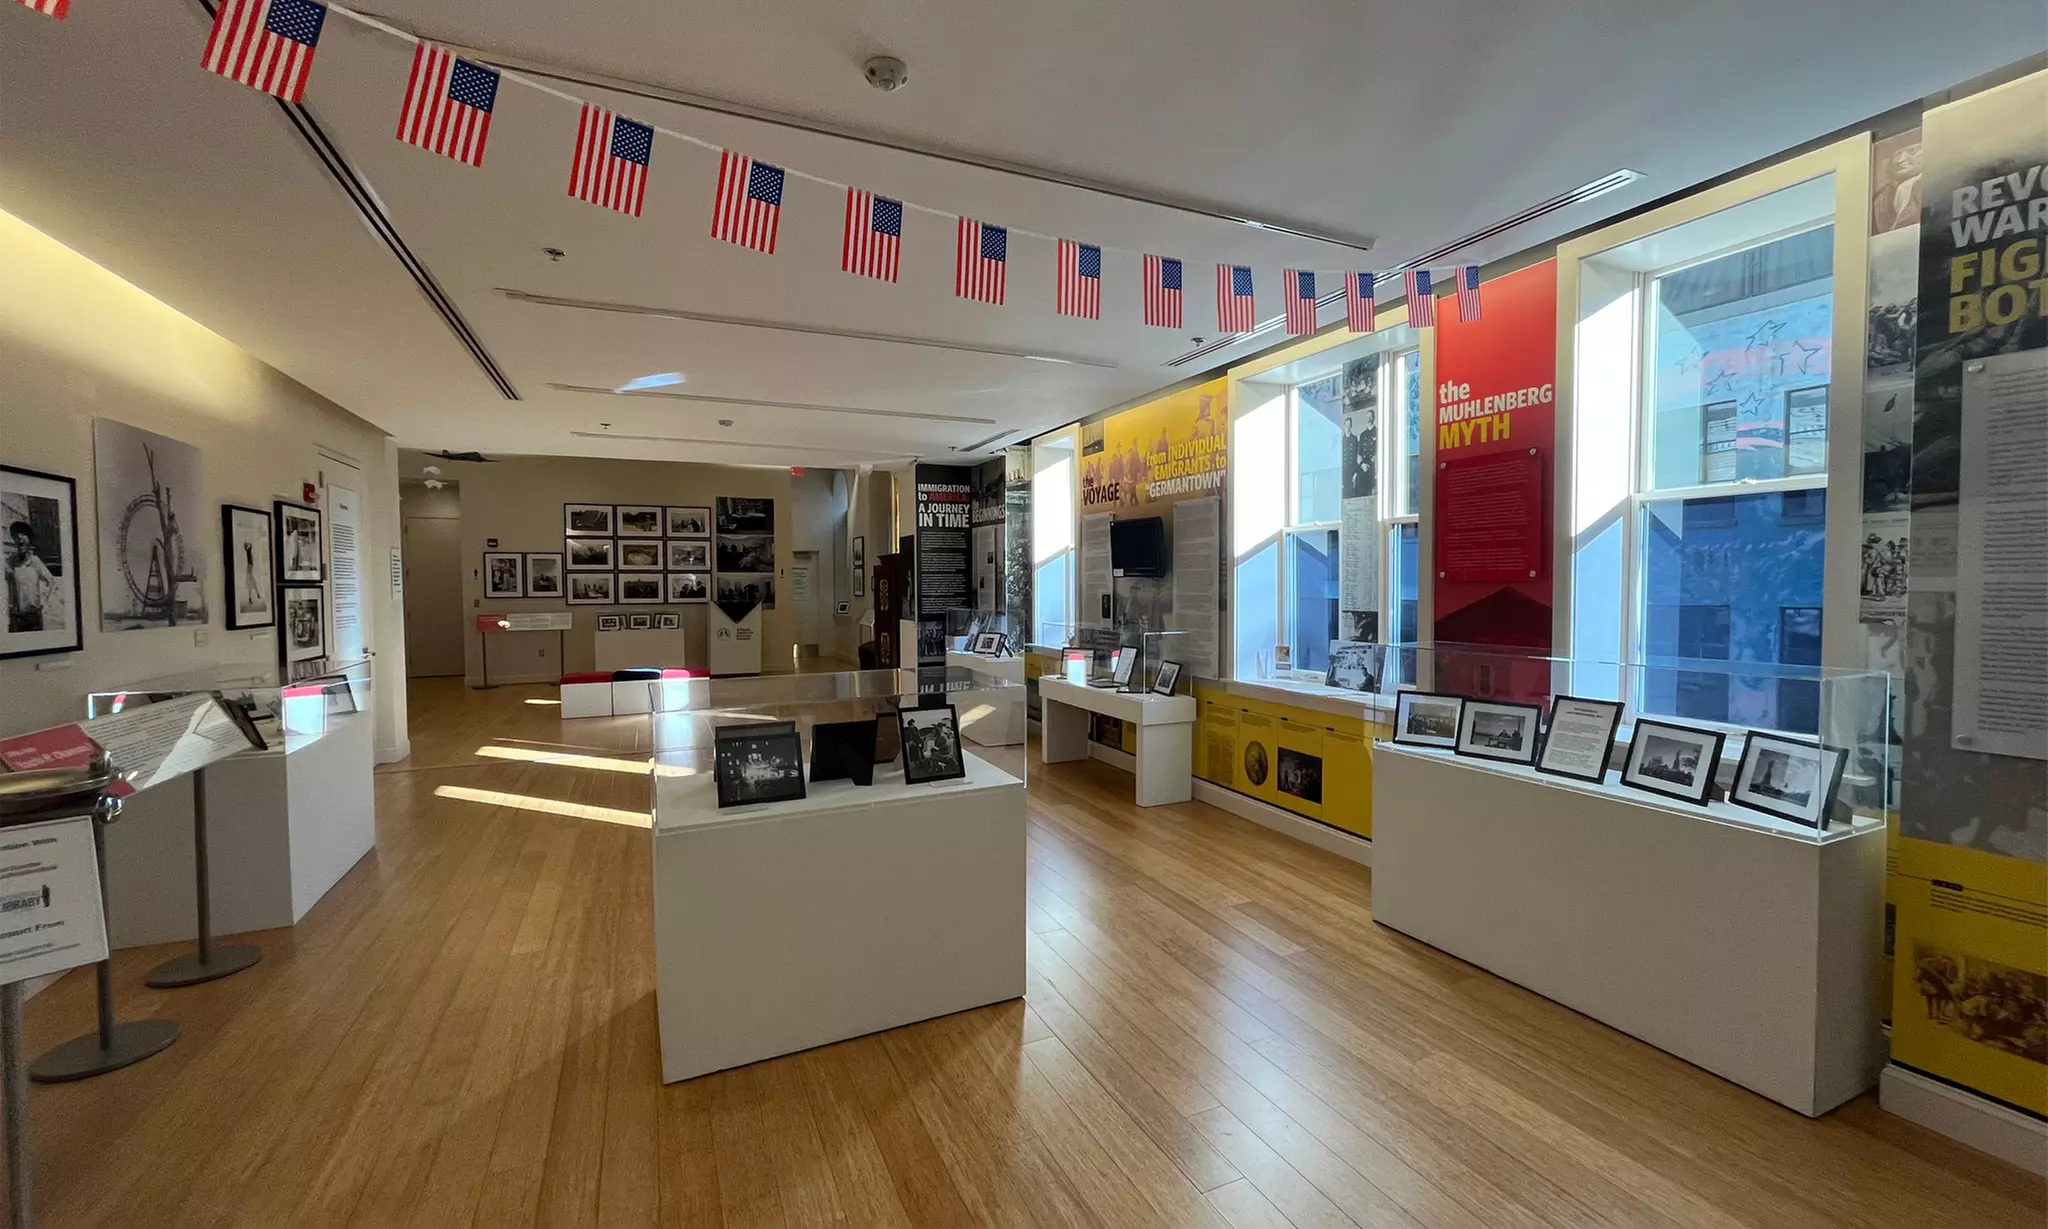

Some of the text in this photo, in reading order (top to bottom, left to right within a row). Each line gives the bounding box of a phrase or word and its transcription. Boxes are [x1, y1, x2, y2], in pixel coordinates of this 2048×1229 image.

[1950, 197, 2048, 248] WAR
[1950, 235, 2048, 293] FIG
[1948, 279, 2048, 334] BOT
[1439, 380, 1470, 405] the
[1439, 383, 1553, 425] MUHLENBERG
[1439, 413, 1511, 451] MYTH
[1146, 434, 1227, 466] from INDIVIDUAL
[1154, 453, 1226, 481] EMIGRANTS to
[917, 483, 970, 493] IMMIGRATION
[1083, 474, 1094, 488] the
[1083, 482, 1120, 506] VOYAGE
[918, 492, 928, 501] to
[918, 503, 970, 513] A JOURNEY
[918, 513, 970, 528] IN TIME
